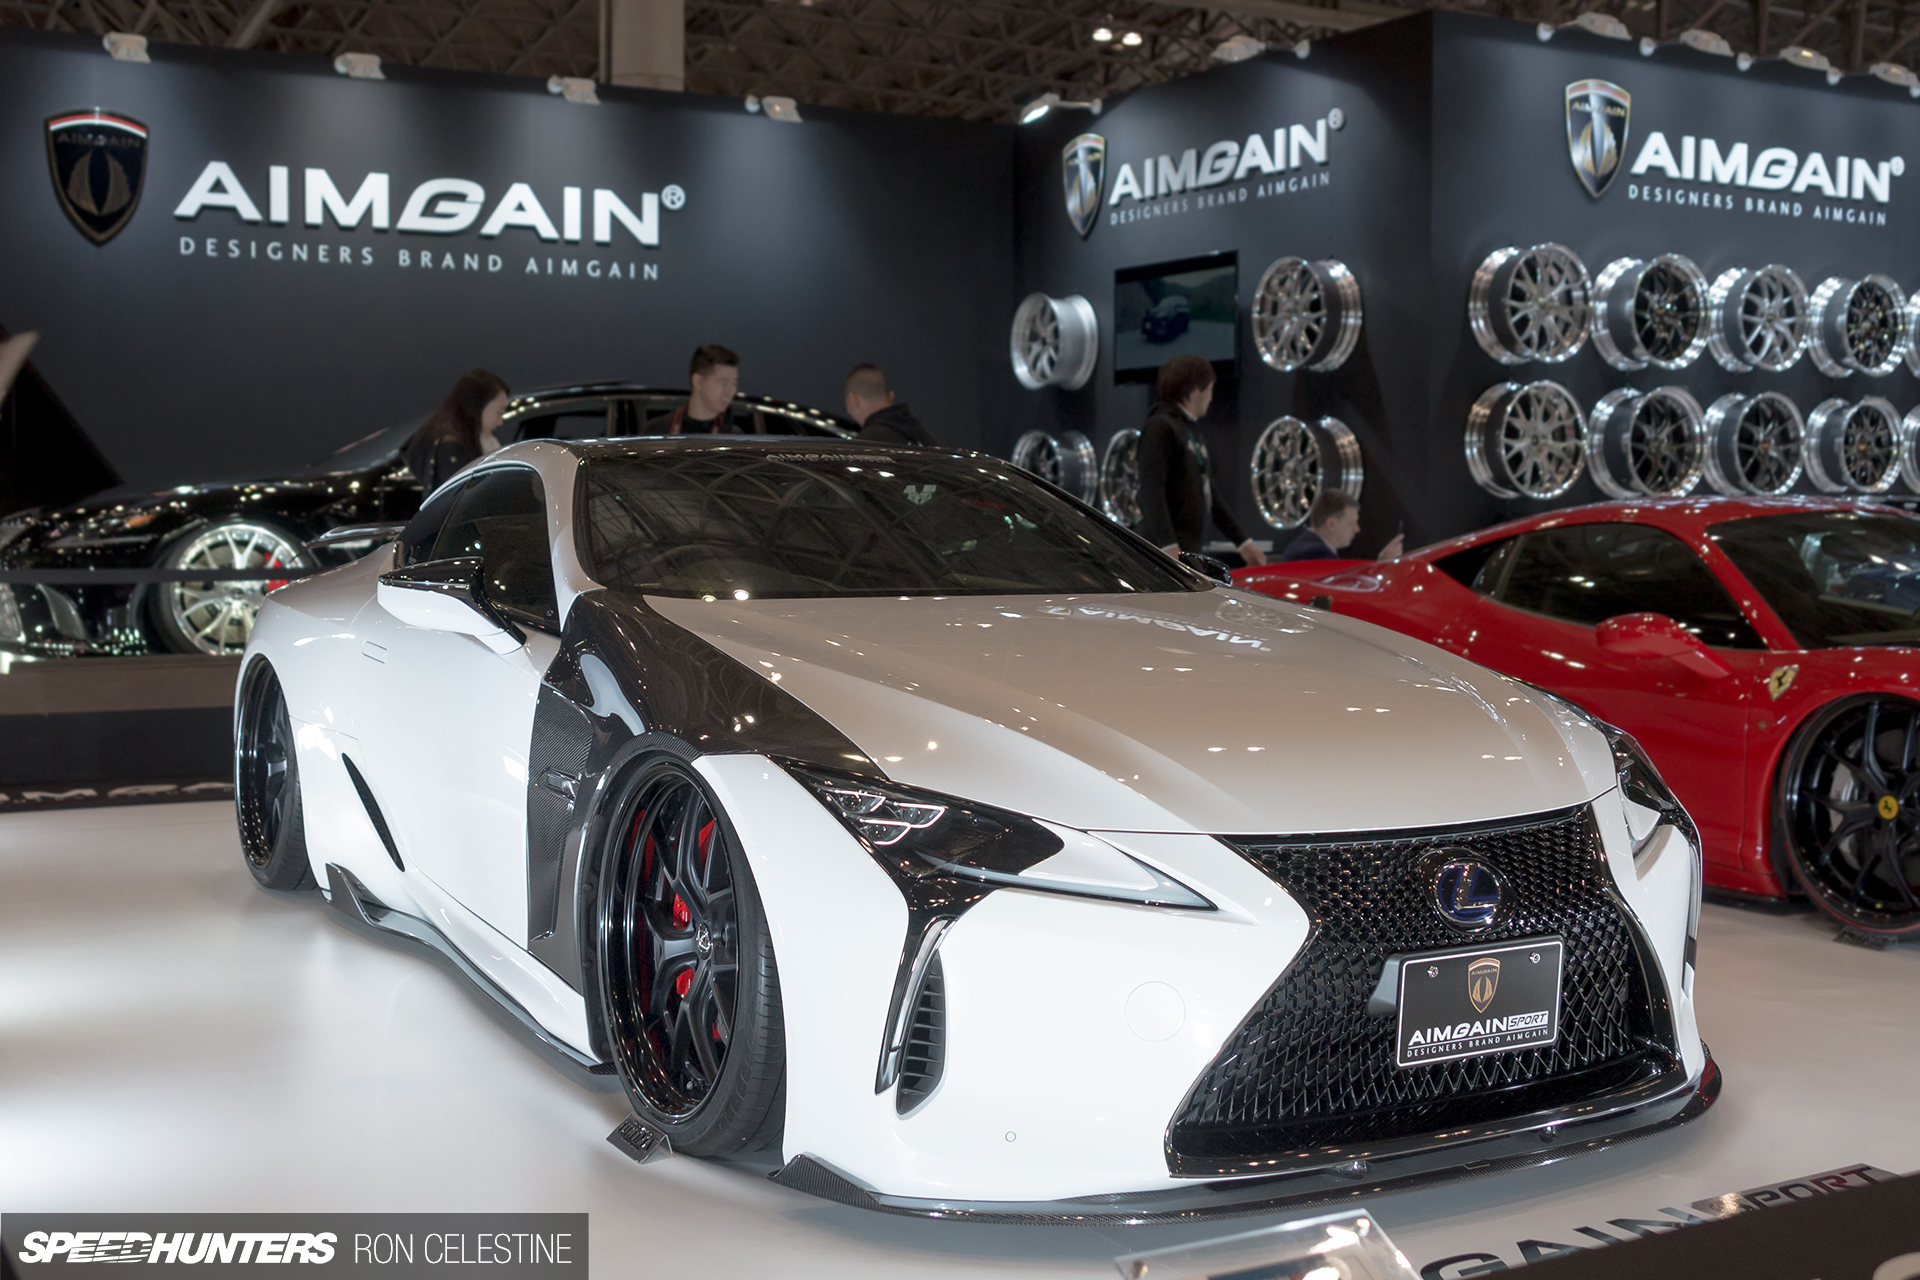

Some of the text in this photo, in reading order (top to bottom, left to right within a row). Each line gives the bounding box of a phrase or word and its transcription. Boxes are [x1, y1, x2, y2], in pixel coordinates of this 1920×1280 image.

[1110, 171, 1330, 226] DESIGNERS BRAND AIMGAIN
[1628, 184, 1887, 226] DESIGNERS BRAND AIMGAIN
[179, 236, 659, 281] DESIGNERS BRAND AIMGAIN
[1406, 1028, 1549, 1058] DESIGNERS BRAND AIMGAIN
[1408, 1012, 1548, 1046] AIMGAIN SPORT
